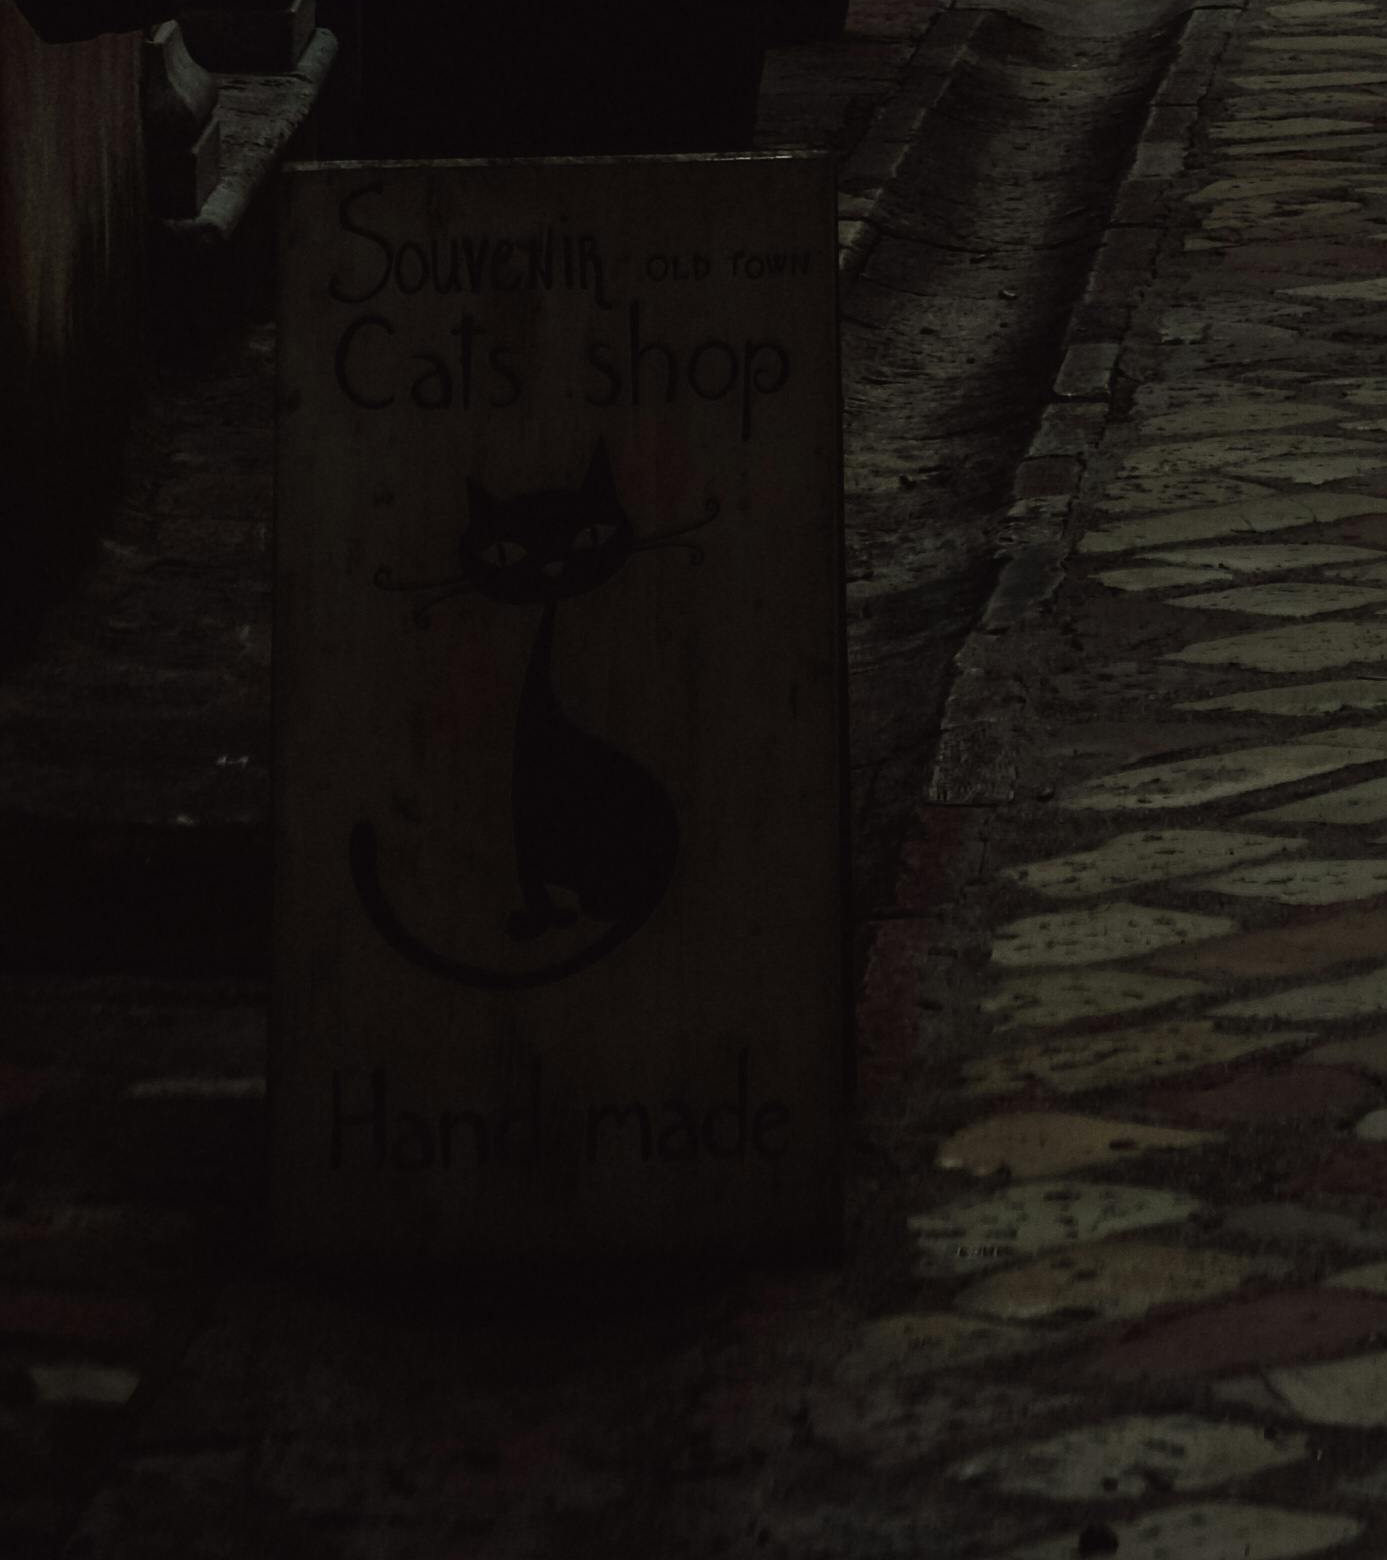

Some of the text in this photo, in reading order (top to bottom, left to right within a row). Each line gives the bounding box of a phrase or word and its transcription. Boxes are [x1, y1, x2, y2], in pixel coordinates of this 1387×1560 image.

[645, 251, 711, 282] OLD
[730, 249, 811, 281] TOWN
[335, 298, 792, 442] Cats shop
[331, 1046, 790, 1172] Hand made
